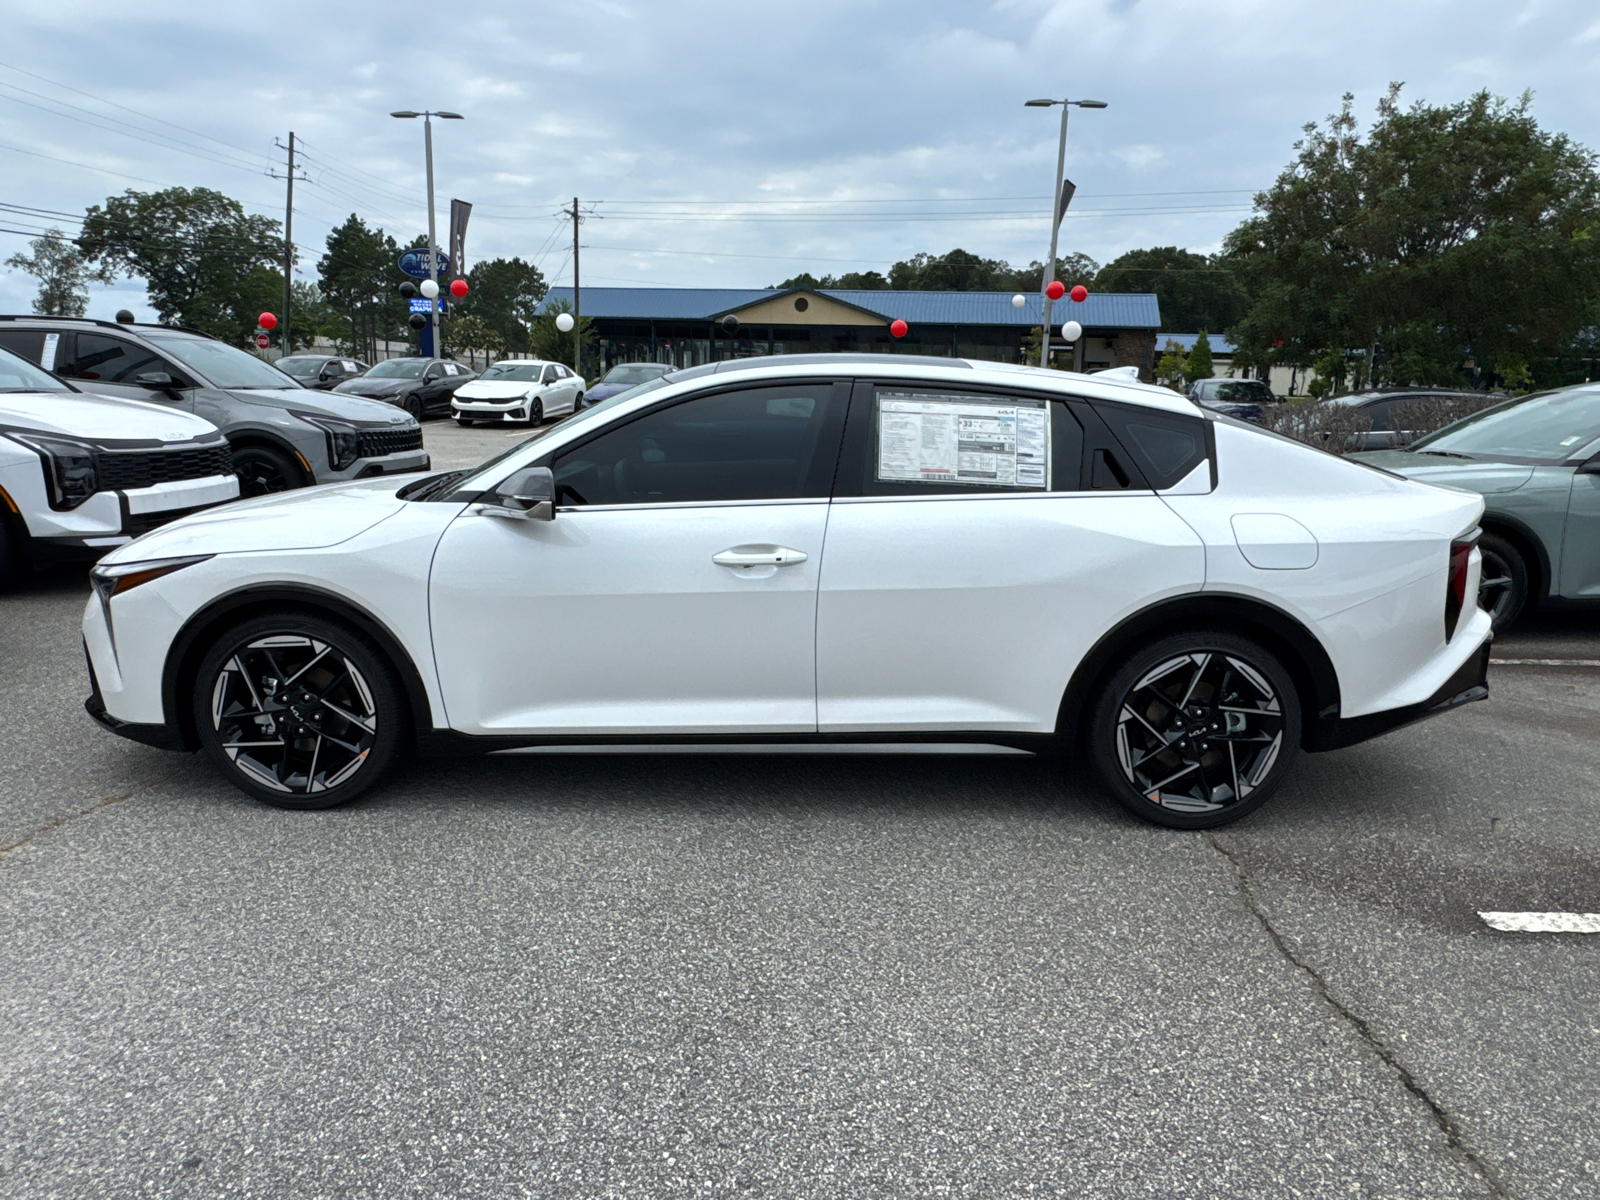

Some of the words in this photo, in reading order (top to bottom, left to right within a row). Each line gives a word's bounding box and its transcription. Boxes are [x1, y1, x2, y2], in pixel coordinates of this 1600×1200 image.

[416, 254, 442, 262] TIDL
[421, 262, 447, 270] WVE
[1188, 727, 1207, 737] KIA
